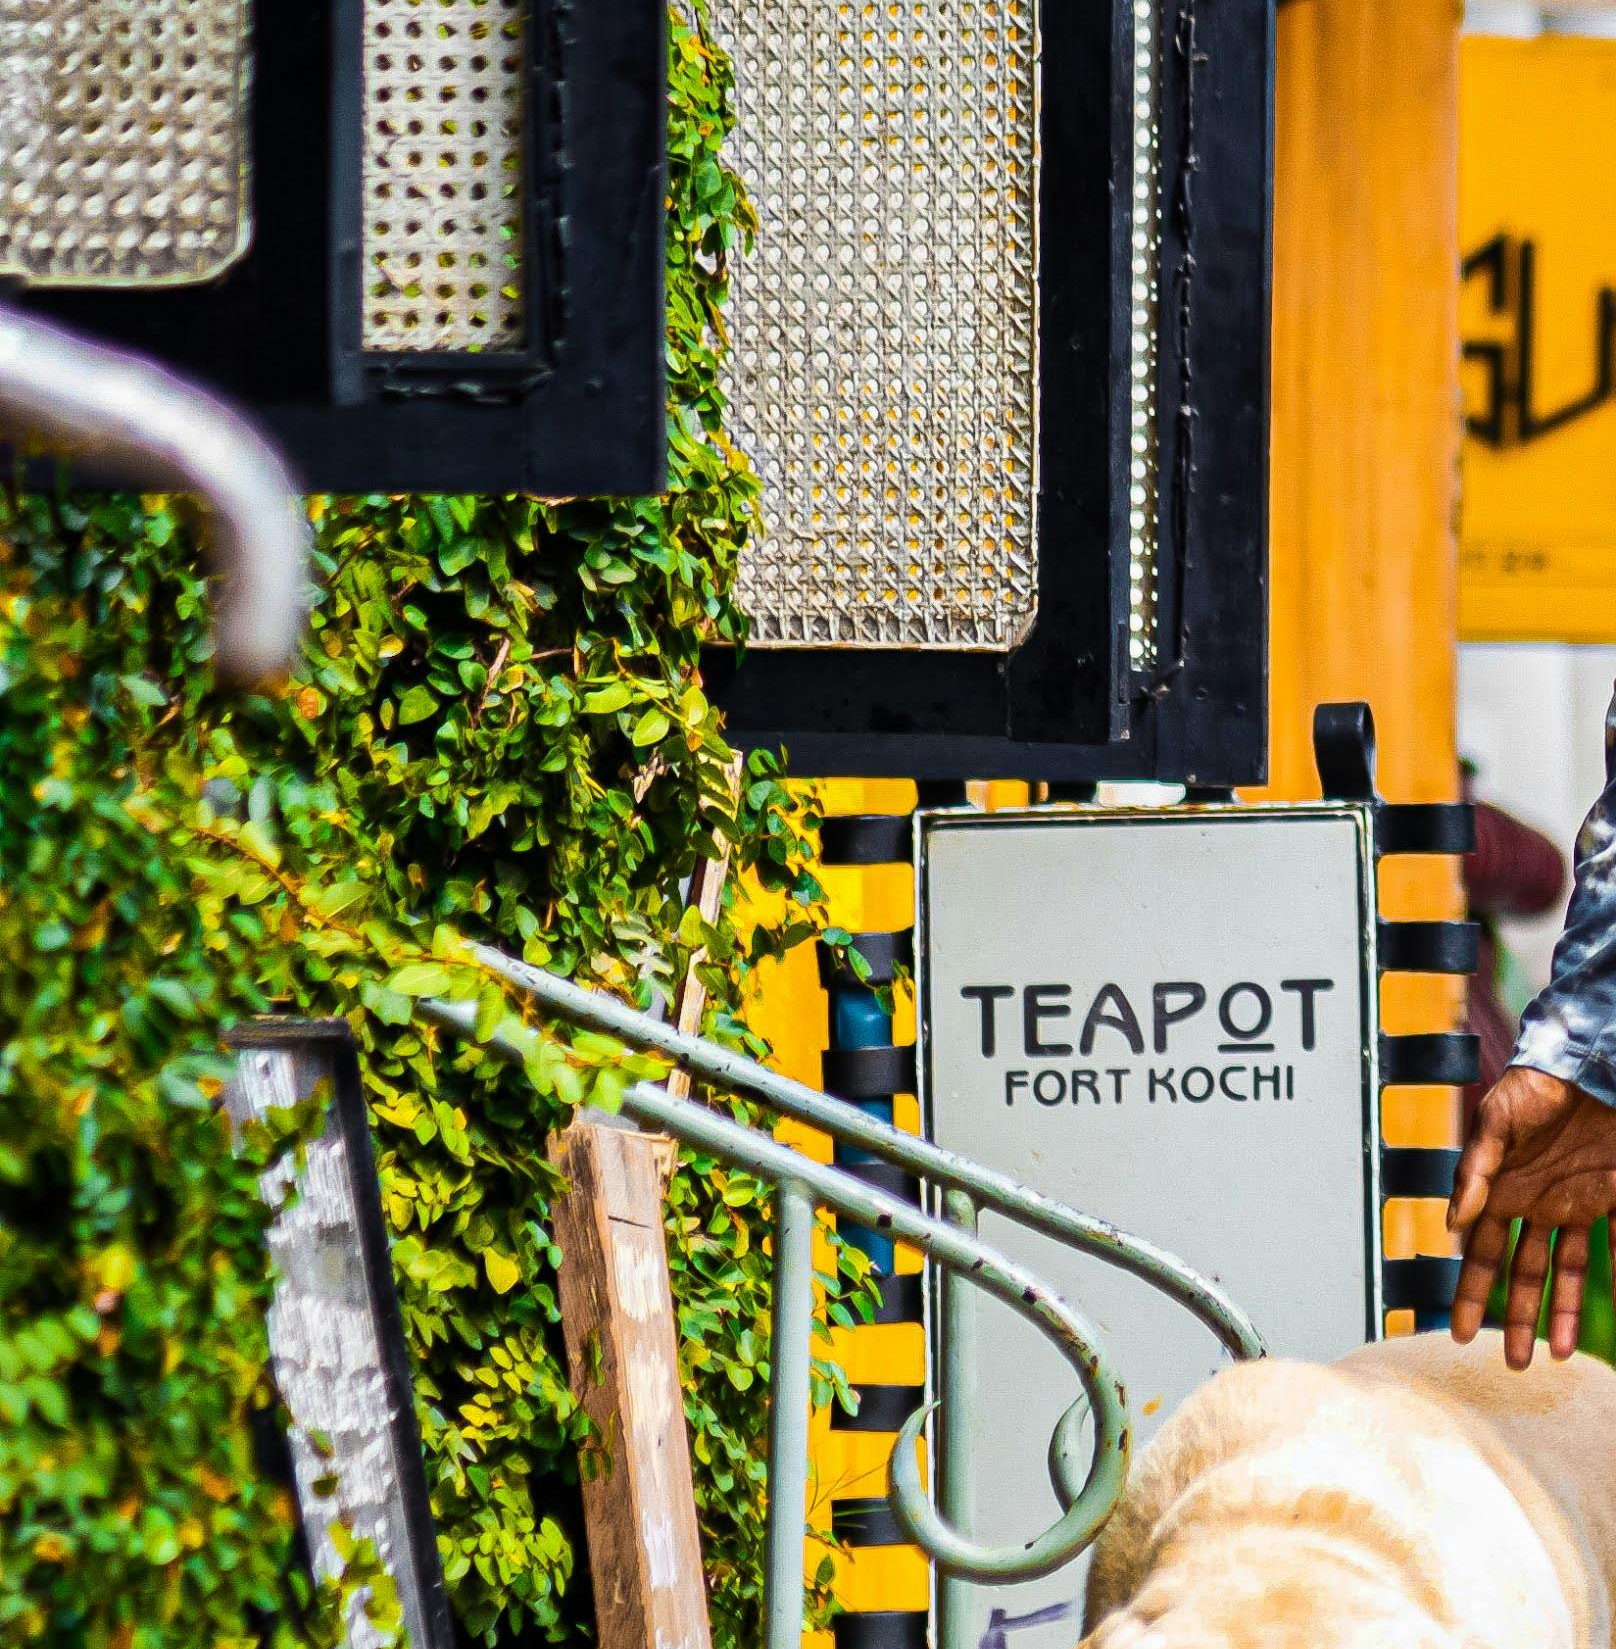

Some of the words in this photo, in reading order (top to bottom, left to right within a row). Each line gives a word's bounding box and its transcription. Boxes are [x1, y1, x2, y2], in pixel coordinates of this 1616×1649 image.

[960, 978, 1335, 1058] TEAPOT
[1004, 1067, 1131, 1107] FORT
[1147, 1063, 1296, 1105] KOCHI
